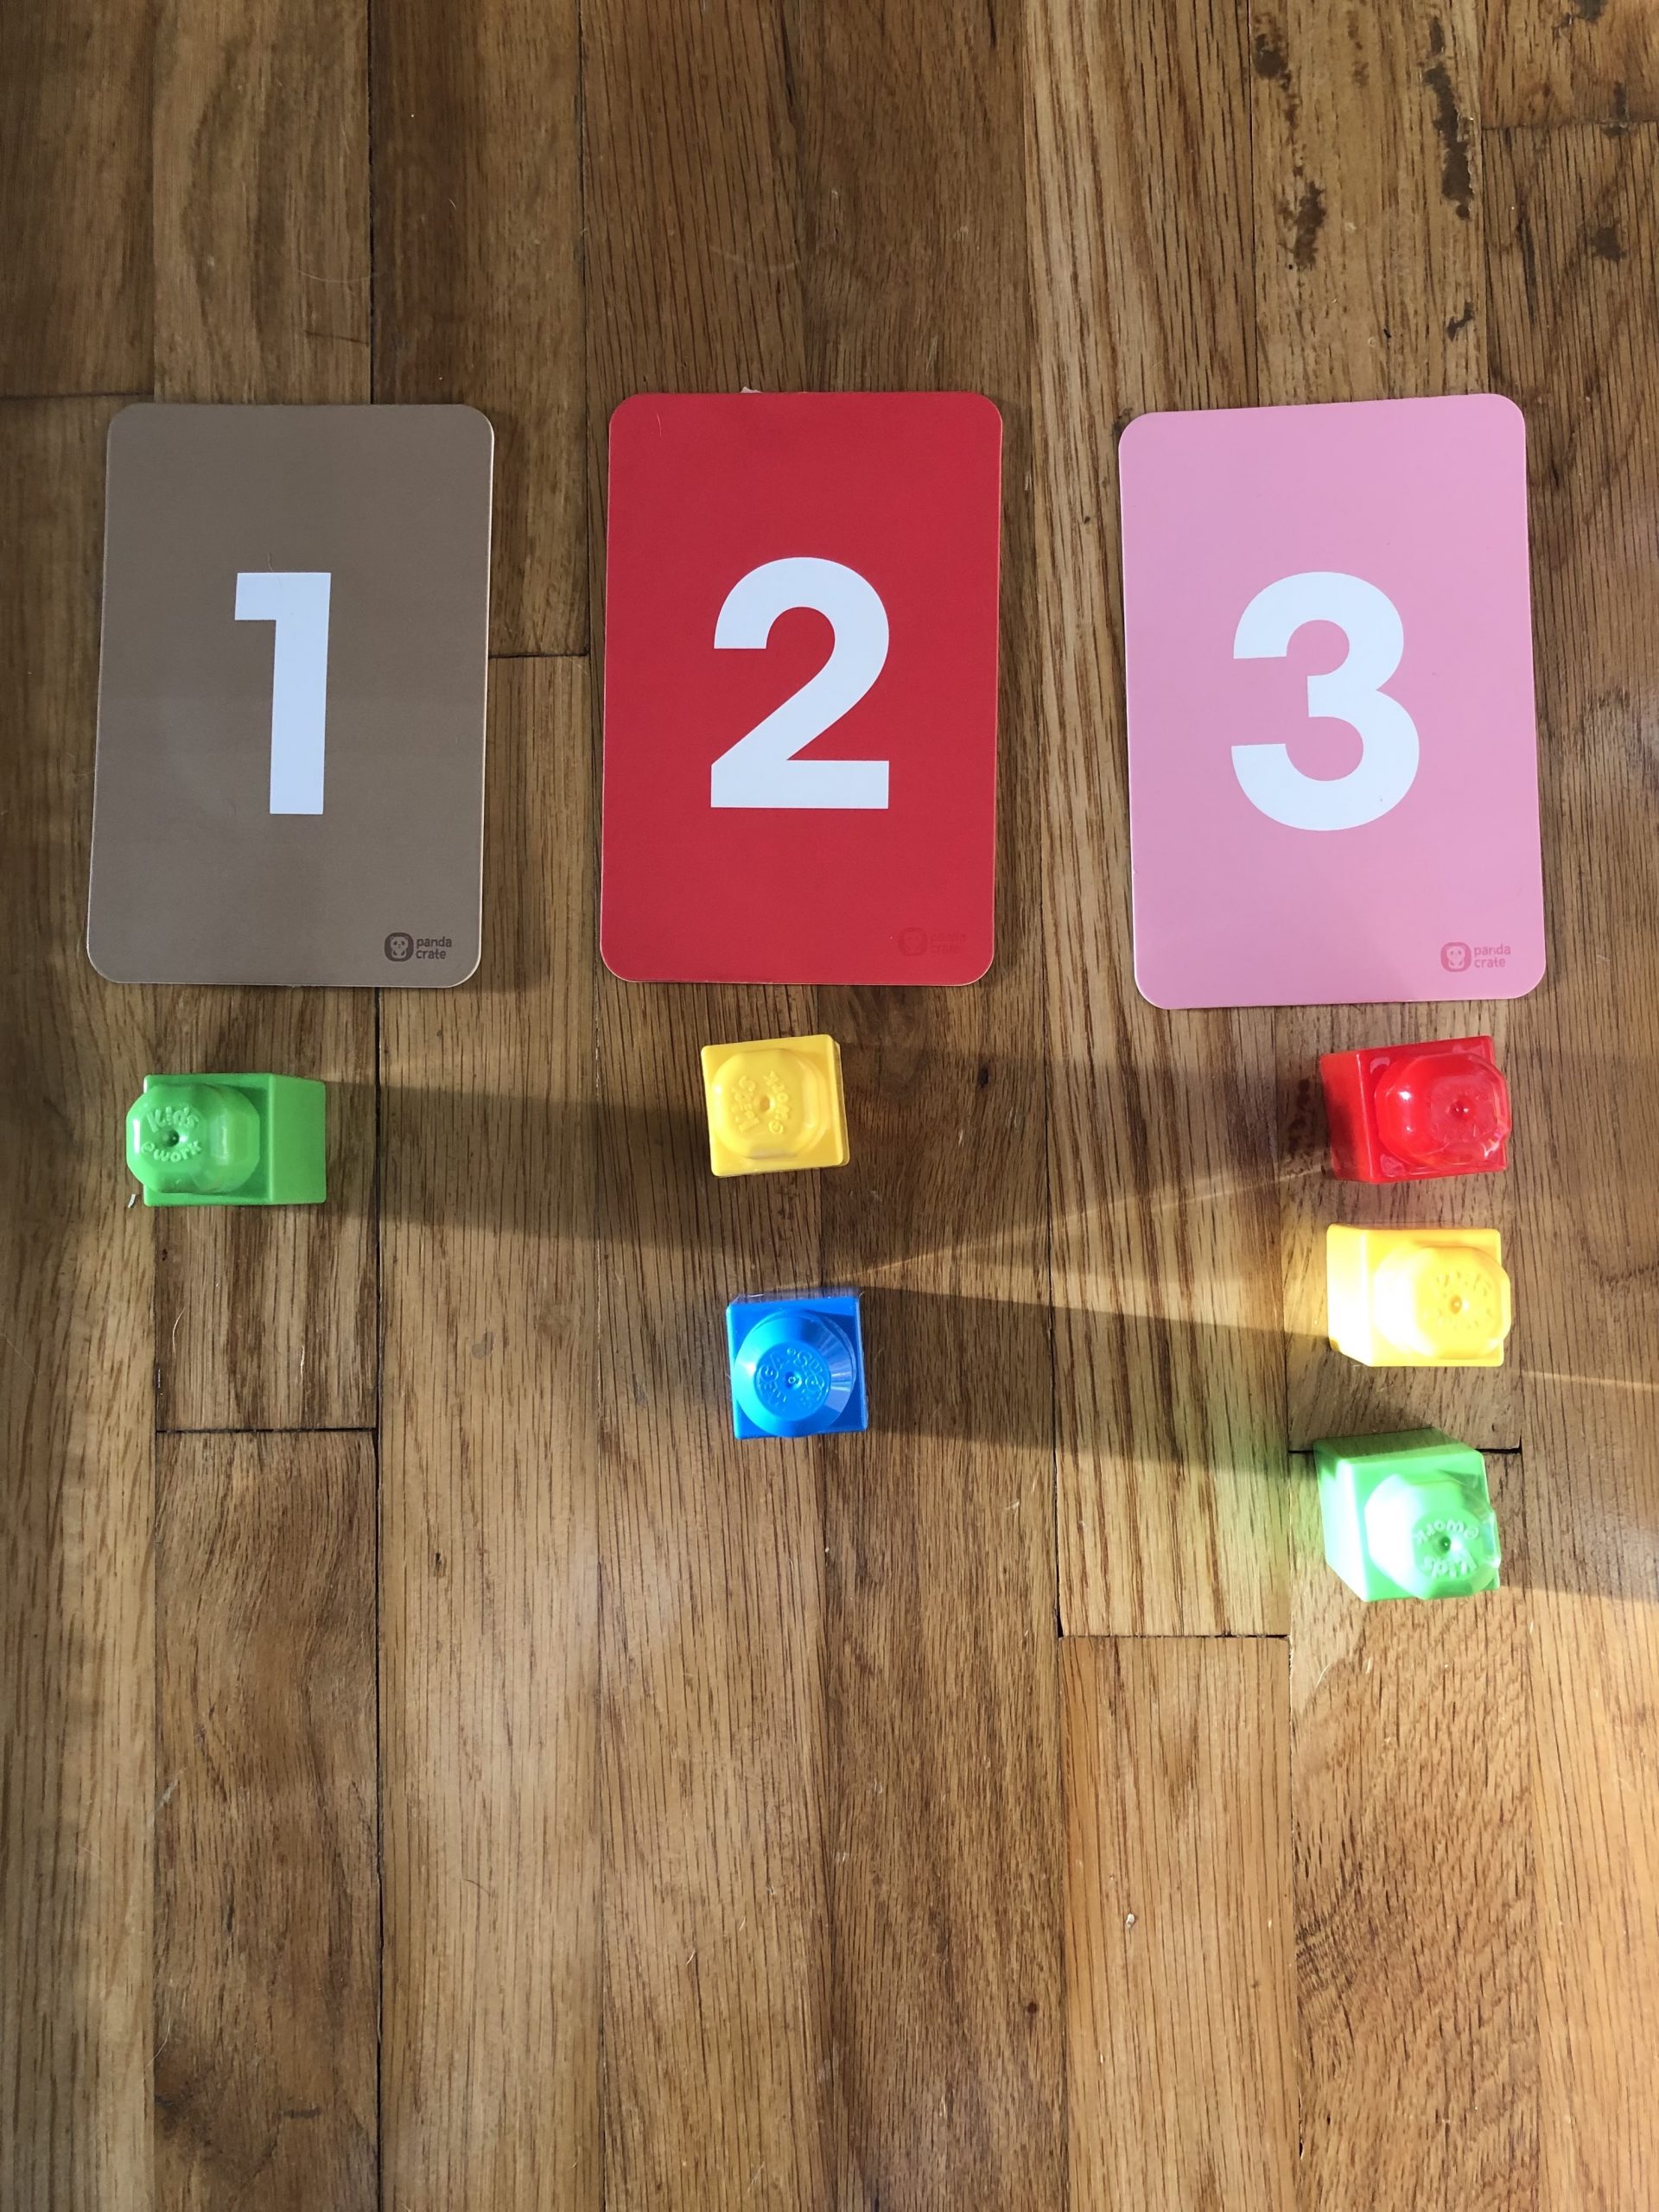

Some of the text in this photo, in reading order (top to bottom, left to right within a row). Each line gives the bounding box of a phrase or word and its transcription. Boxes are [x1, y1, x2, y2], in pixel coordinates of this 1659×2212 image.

[710, 557, 890, 810] 2
[233, 572, 332, 816] 1
[1230, 571, 1421, 831] 3
[416, 936, 453, 949] panda
[416, 949, 447, 960] crate
[1473, 943, 1511, 957] panda
[1473, 957, 1506, 969] crate
